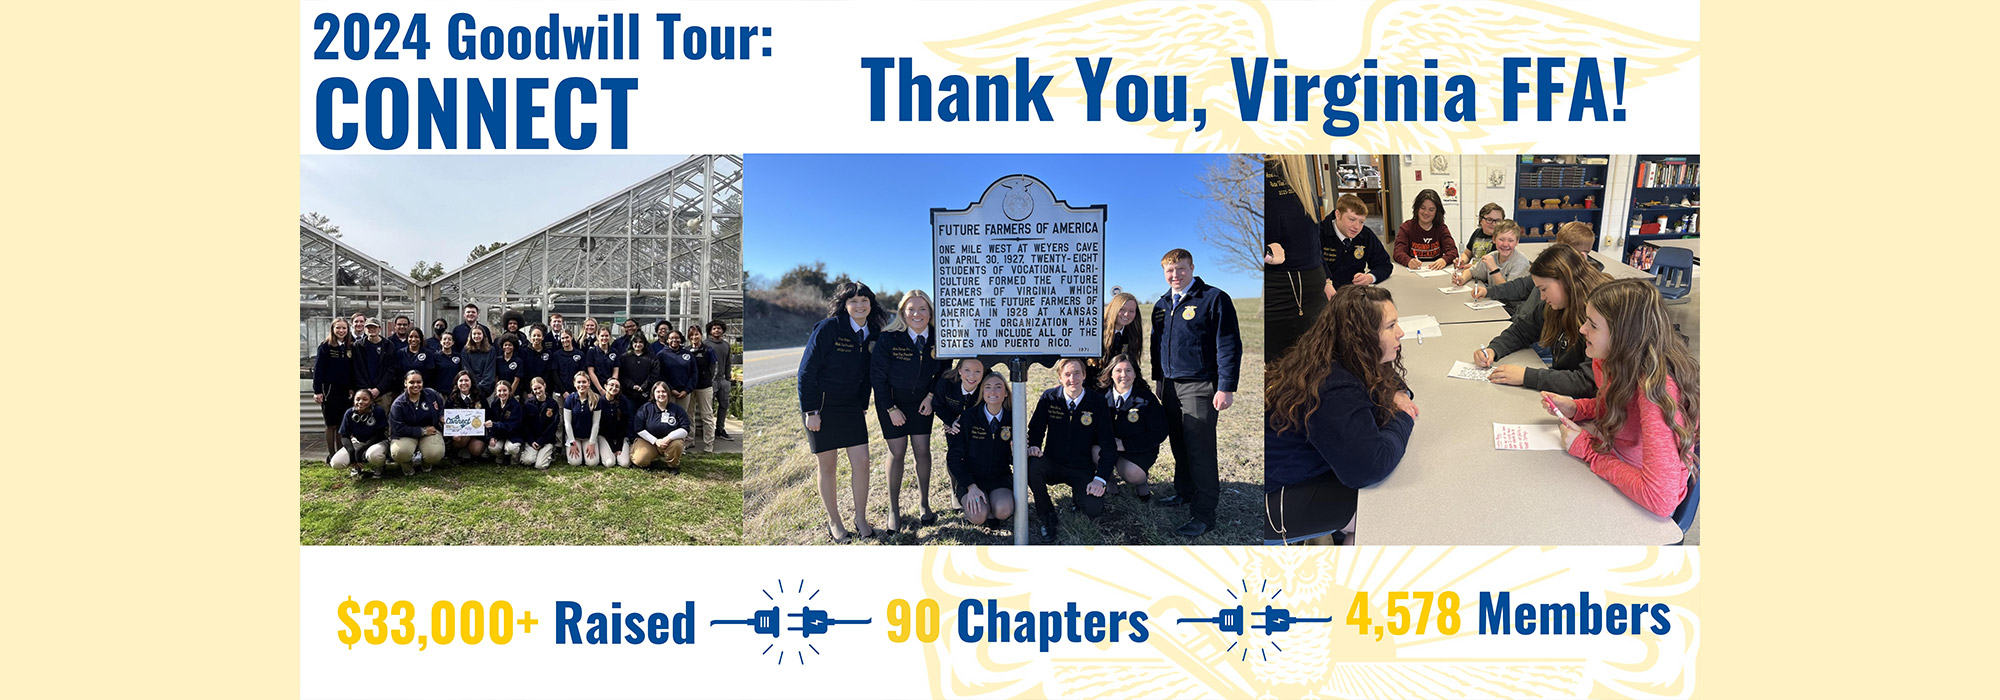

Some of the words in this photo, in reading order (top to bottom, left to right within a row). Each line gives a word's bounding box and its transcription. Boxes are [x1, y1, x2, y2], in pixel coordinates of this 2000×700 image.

[939, 224, 980, 236] FUTURE
[985, 223, 1031, 235] FARMERS
[1036, 222, 1049, 233] OF
[1052, 222, 1098, 233] AMERICA
[939, 246, 955, 254] ONE
[961, 245, 982, 253] MILE
[989, 244, 1012, 253] WEST
[1017, 244, 1028, 253] AT
[1034, 243, 1069, 252] WEYERS
[1076, 242, 1098, 252] CAVE
[939, 256, 950, 264] ON
[956, 255, 980, 264] APRIL
[1031, 253, 1098, 263] TWENTY-EIGHT
[939, 266, 986, 275] STUDENTS
[993, 266, 1004, 274] OF
[1011, 265, 1067, 274] VOCATIONAL
[1073, 264, 1098, 273] AGRI-
[940, 276, 980, 286] CULTURE
[989, 276, 1026, 285] FORMED
[1034, 276, 1051, 285] THE
[1061, 275, 1098, 284] FUTURE
[940, 287, 982, 296] FARMERS
[993, 287, 1005, 296] OF
[1017, 286, 1056, 295] VIRGINIA
[1069, 286, 1098, 295] WHICH
[940, 298, 974, 307] BECAME
[979, 298, 996, 306] THE
[1001, 297, 1035, 306] FUTURE
[1041, 296, 1081, 306] FARMERS
[1086, 296, 1097, 305] OF
[940, 308, 981, 317] AMERICA
[989, 308, 998, 317] IN
[1007, 308, 1028, 316] 1928
[1037, 308, 1047, 316] AT
[1059, 307, 1098, 316] KANSAS
[940, 319, 963, 328] CITY.
[974, 318, 991, 327] THE
[1000, 317, 1068, 327] ORGANIZATION
[1079, 317, 1097, 326] HAS
[940, 329, 969, 338] GROWN
[976, 329, 988, 337] TO
[995, 328, 1032, 337] INCLUDE
[1038, 328, 1056, 337] ALL
[1062, 328, 1073, 337] OF
[1080, 327, 1097, 336] THE
[941, 339, 974, 348] STATES
[981, 339, 998, 348] AND
[1005, 339, 1040, 348] PUERTO
[1048, 338, 1071, 347] RICO.
